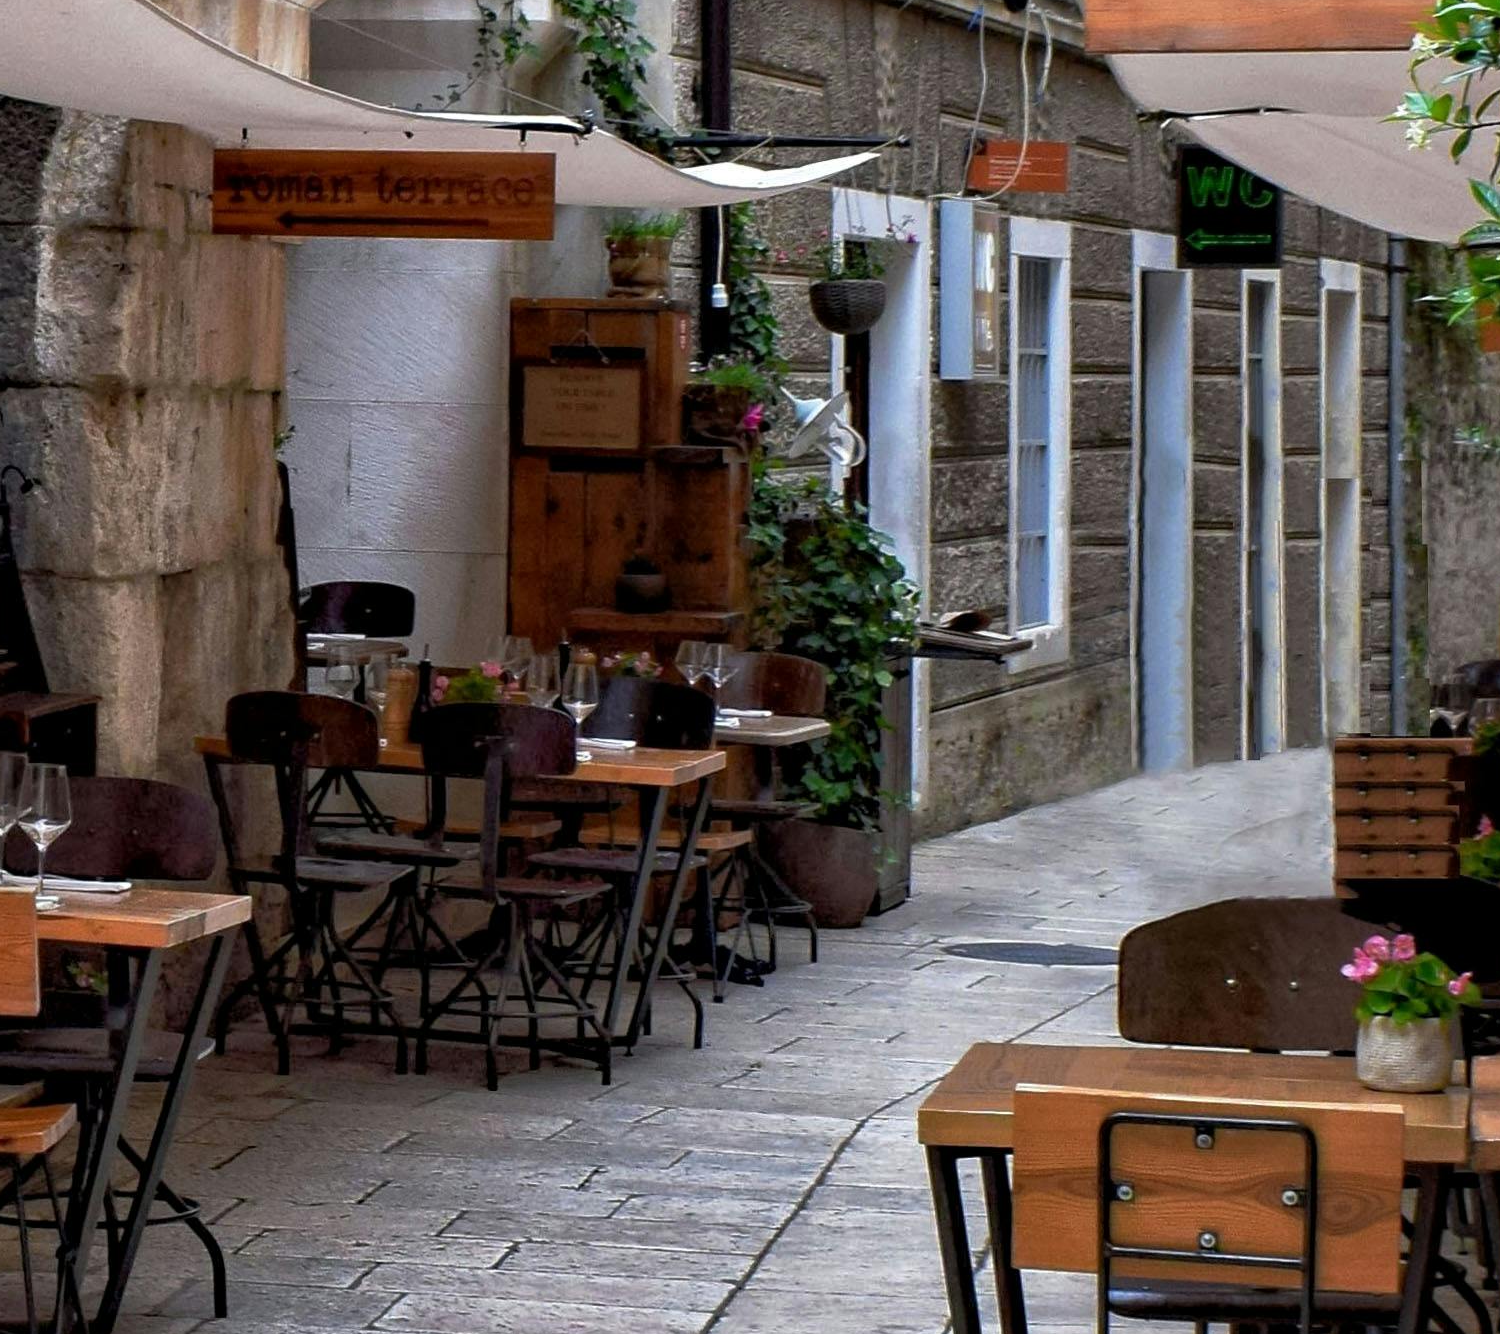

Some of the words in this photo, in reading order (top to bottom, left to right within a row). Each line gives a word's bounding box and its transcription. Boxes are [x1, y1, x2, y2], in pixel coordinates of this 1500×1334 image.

[226, 172, 356, 204] roman
[375, 166, 537, 206] terrace
[1186, 166, 1273, 208] WC
